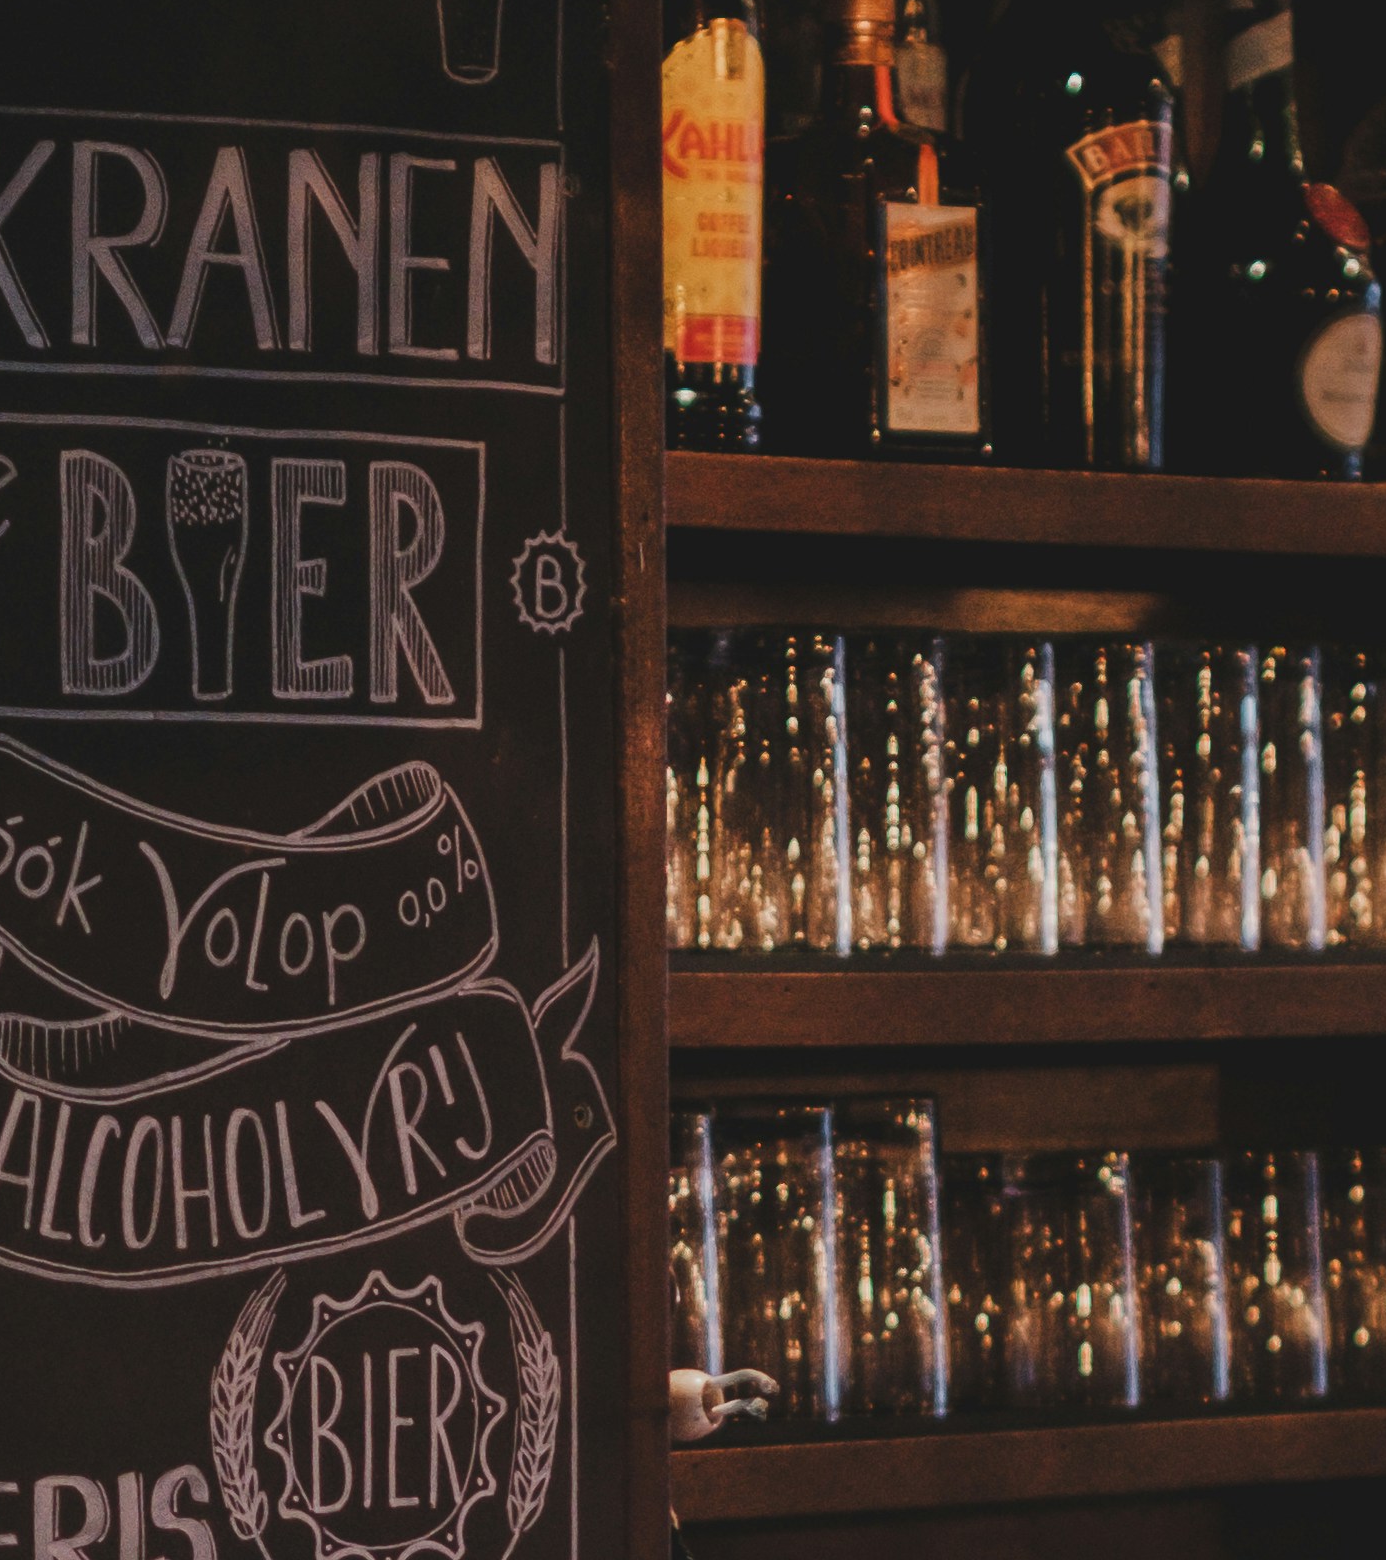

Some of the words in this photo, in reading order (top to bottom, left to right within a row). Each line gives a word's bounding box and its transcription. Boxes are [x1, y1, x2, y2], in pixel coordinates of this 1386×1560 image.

[889, 223, 976, 274] COINTREAU
[396, 824, 480, 928] 0,0%
[310, 1345, 463, 1515] BIER
